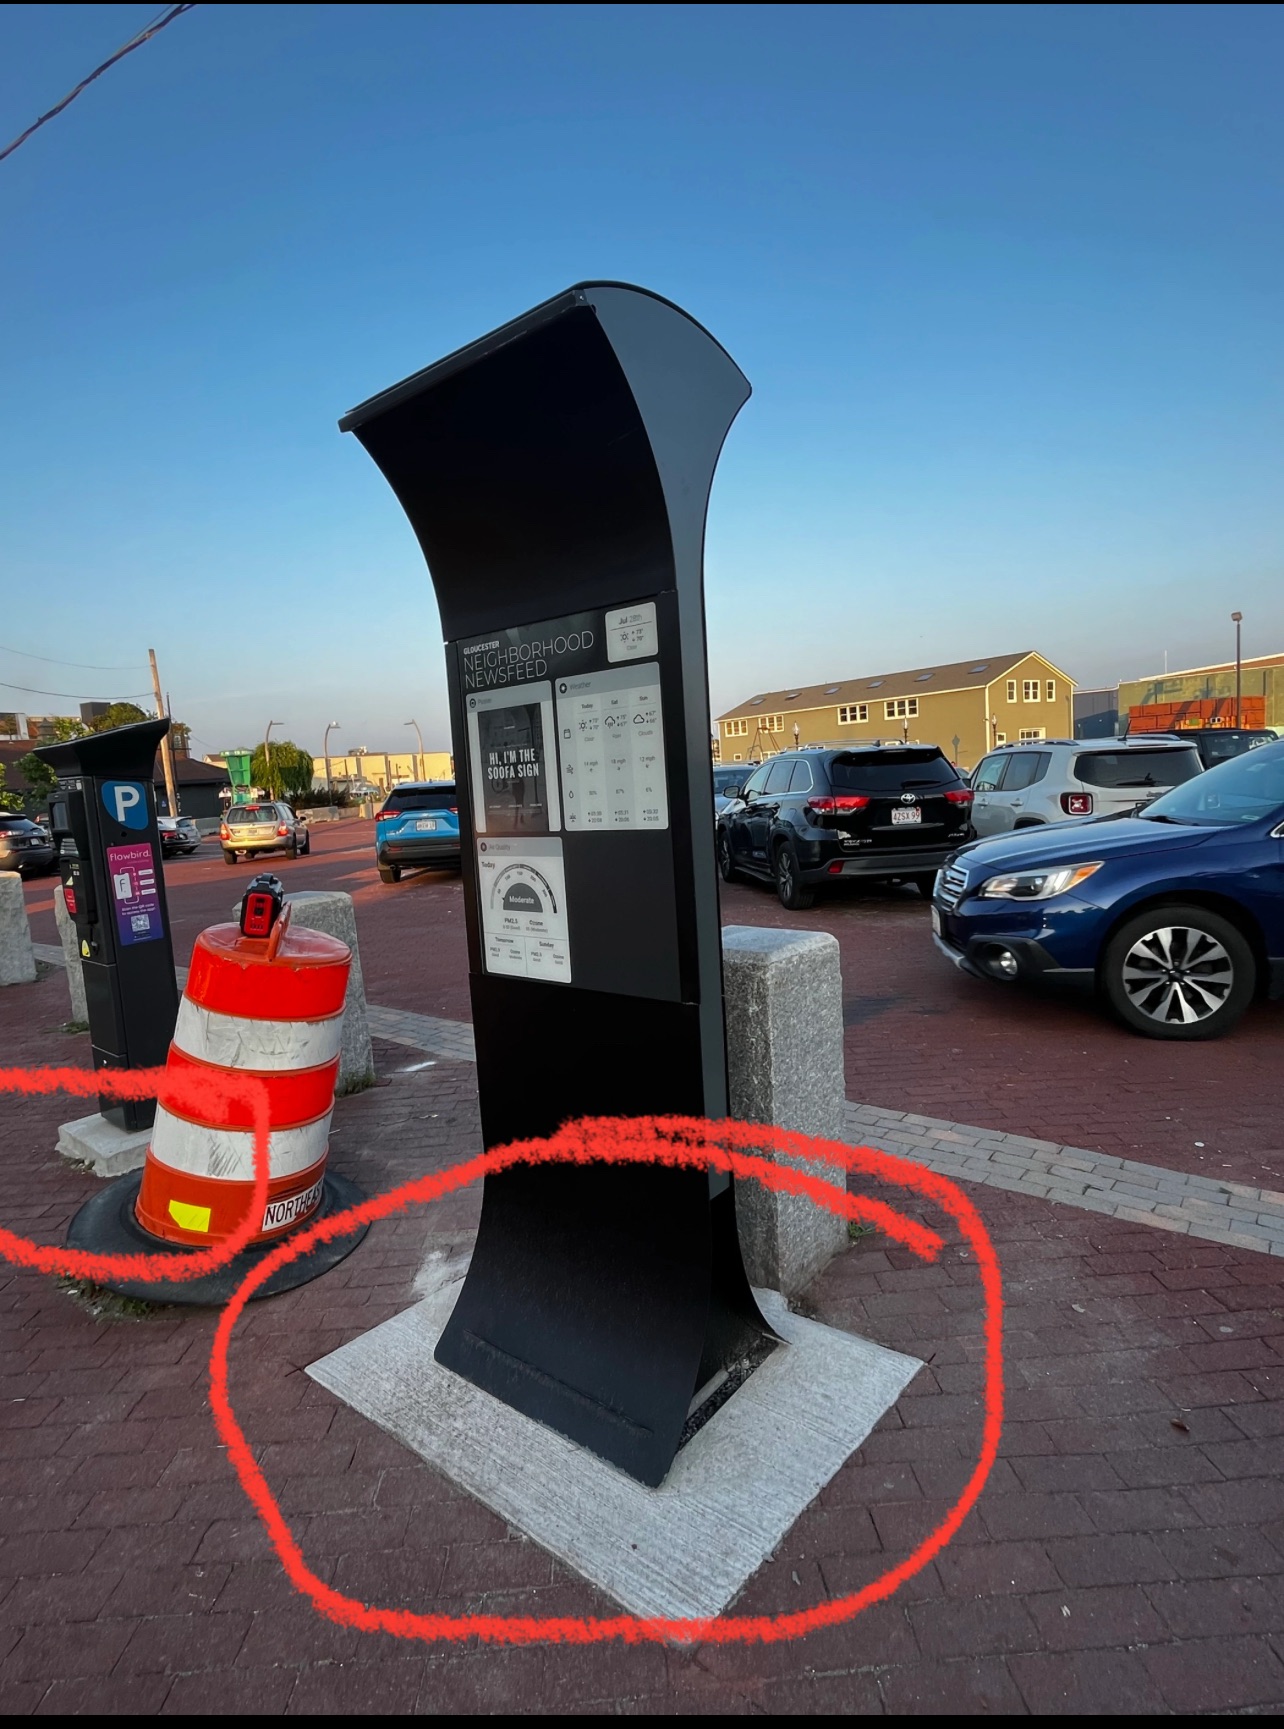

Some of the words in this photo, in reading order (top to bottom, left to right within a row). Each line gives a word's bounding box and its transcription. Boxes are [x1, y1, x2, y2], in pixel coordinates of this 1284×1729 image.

[619, 616, 628, 625] Jul
[463, 640, 500, 656] GLOUCESTER
[463, 630, 594, 673] NEIGHBORHOOD
[465, 659, 548, 690] NEWSFEED
[569, 681, 591, 690] Weather
[489, 752, 502, 766] HI,
[503, 750, 517, 764] I'M
[519, 748, 536, 762] THE
[487, 764, 516, 780] SOOFA
[517, 763, 540, 778] SIGN
[113, 785, 140, 822] P
[481, 861, 496, 870] Today
[509, 895, 535, 905] Moderate
[539, 941, 555, 949] Sunday
